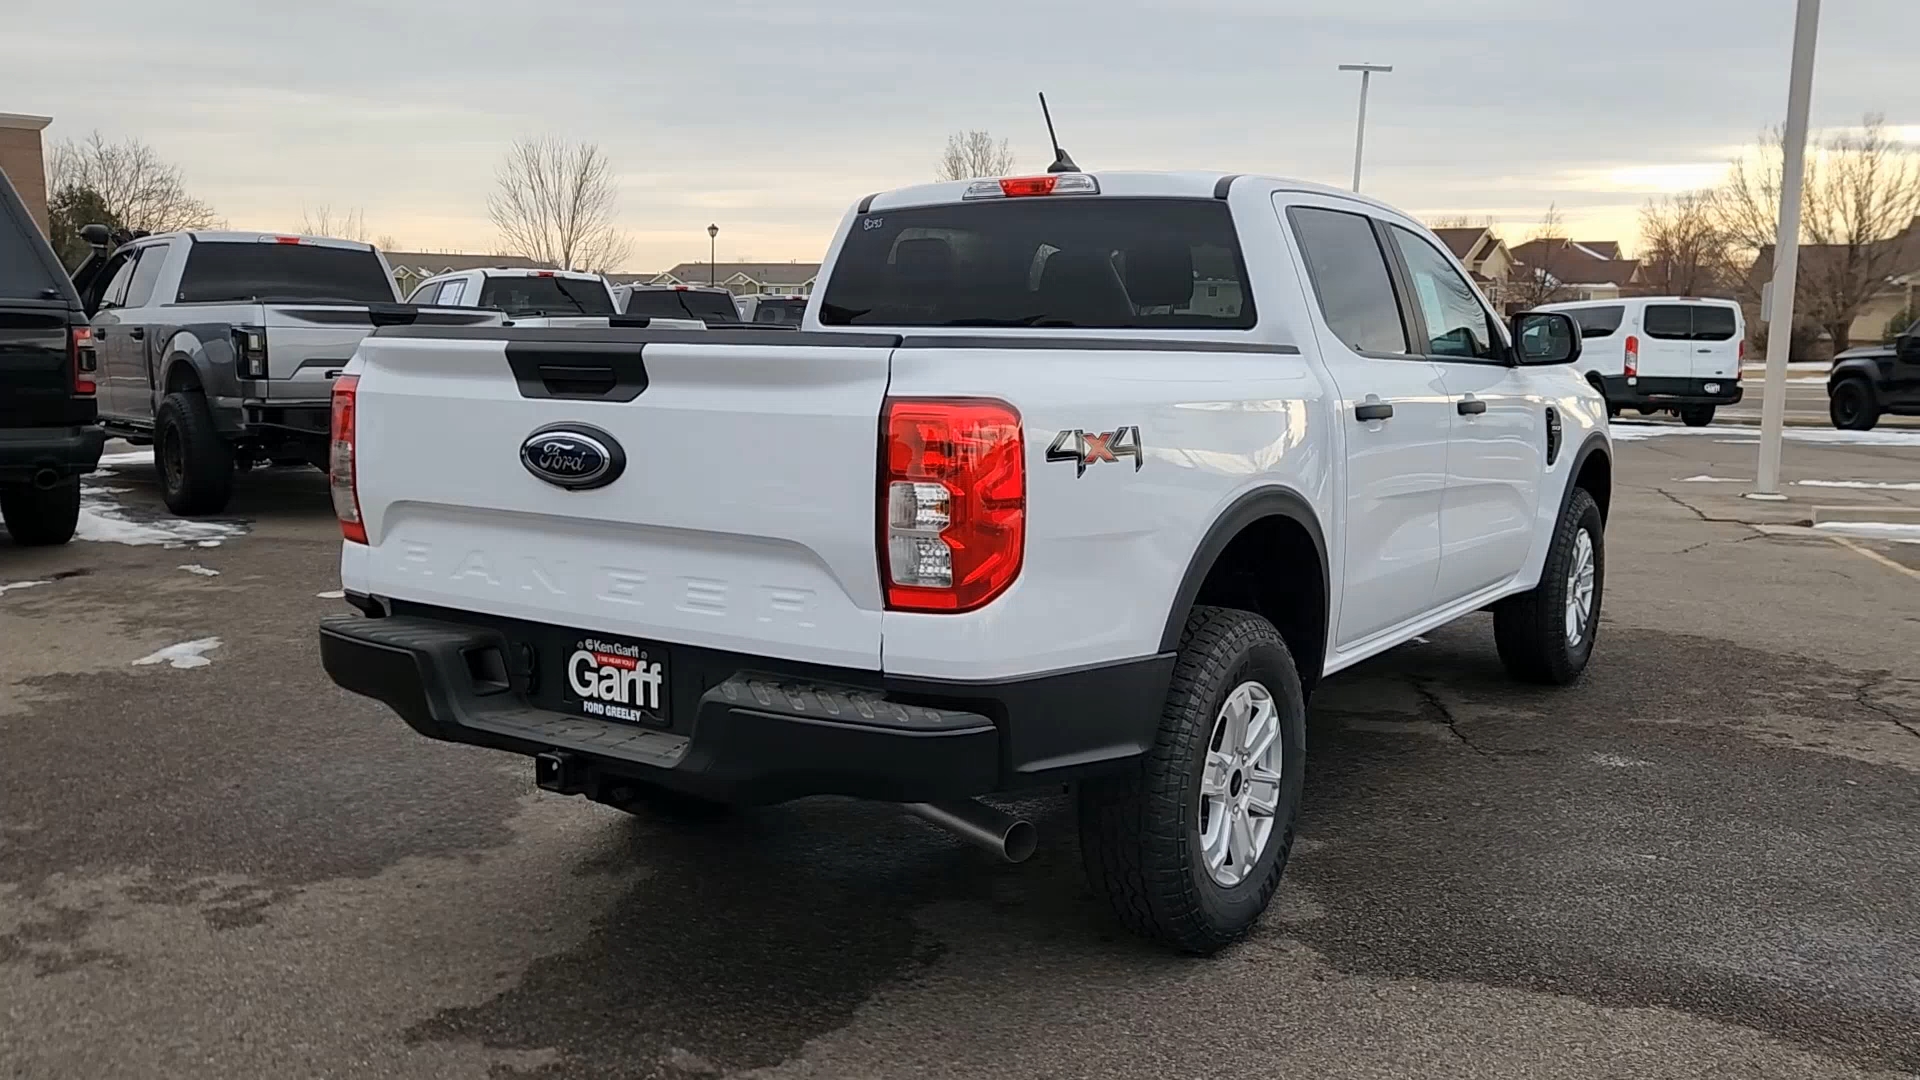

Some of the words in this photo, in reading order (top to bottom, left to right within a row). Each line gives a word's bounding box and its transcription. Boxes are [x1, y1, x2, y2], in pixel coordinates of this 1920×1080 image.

[539, 441, 587, 471] Ford
[396, 538, 818, 628] RANGER
[593, 640, 613, 653] Ken
[614, 643, 640, 658] Garff
[568, 649, 662, 709] Garff
[583, 700, 604, 715] FORD
[605, 705, 642, 722] GREELEY
